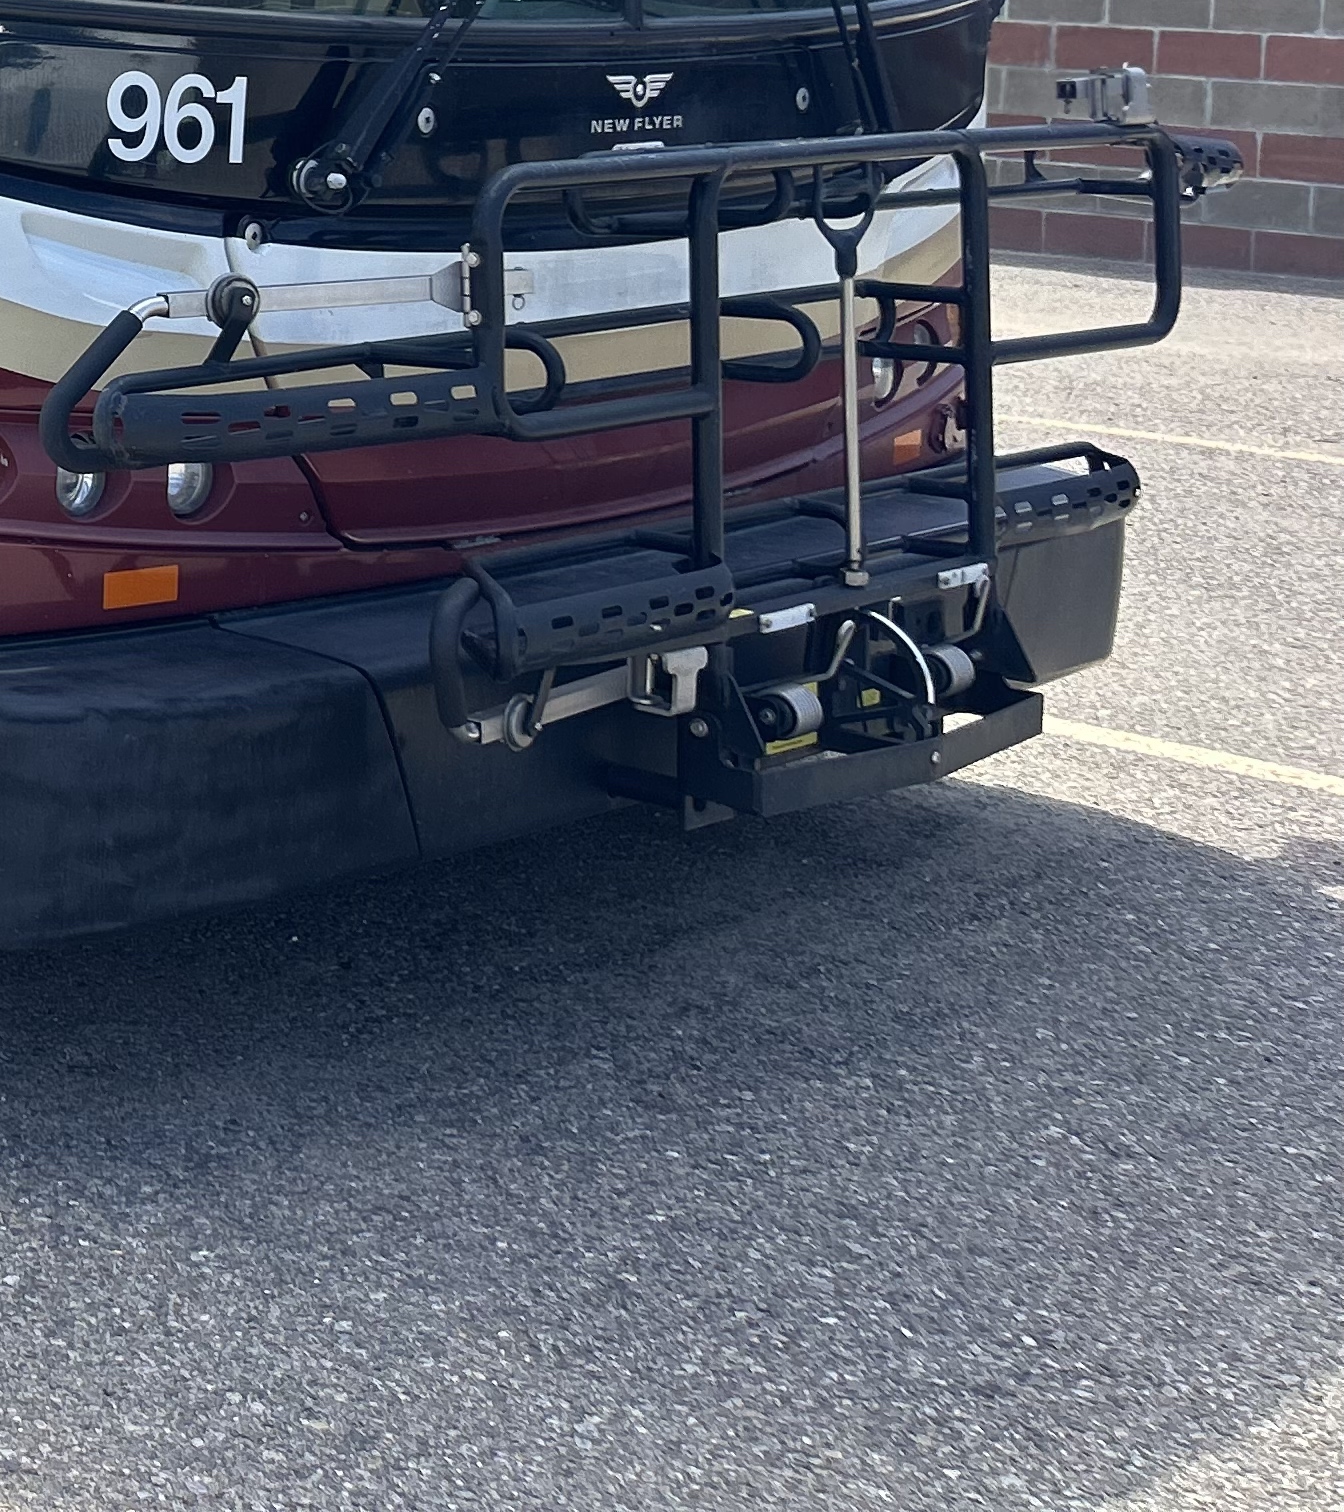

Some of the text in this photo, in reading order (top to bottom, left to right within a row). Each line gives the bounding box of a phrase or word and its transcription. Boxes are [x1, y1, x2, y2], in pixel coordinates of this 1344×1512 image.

[106, 70, 248, 164] 961
[590, 115, 683, 133] NEW FLYER
